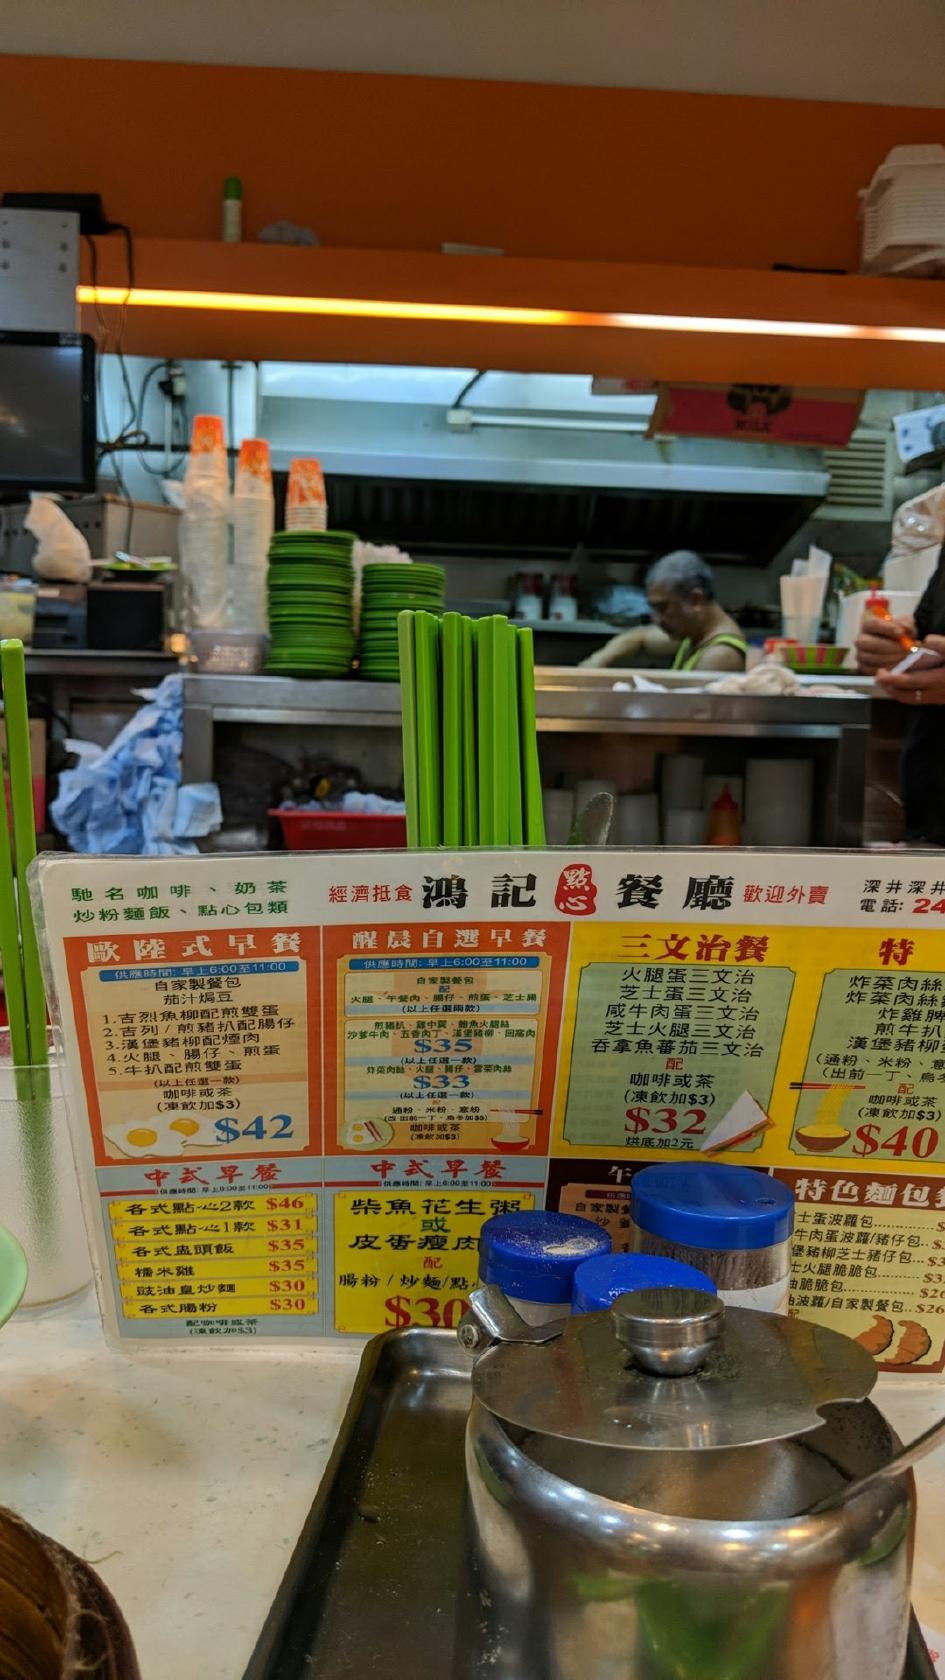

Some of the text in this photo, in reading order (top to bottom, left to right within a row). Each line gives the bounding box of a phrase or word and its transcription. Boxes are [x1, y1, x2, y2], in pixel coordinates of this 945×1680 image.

[71, 881, 287, 902] 馳名咖啡、奶茶
[329, 884, 413, 903] 經濟抵食
[422, 873, 736, 910] 鴻記 餐廳
[743, 884, 829, 905] 歡迎外賣
[73, 901, 288, 923] 炒粉麵飯、點心包類
[86, 933, 302, 963] 歐陸式早餐
[617, 933, 770, 963] 三文治餐
[879, 937, 915, 966] 特
[155, 977, 241, 991] 自家製餐包
[621, 967, 755, 985] 火腿蛋三文治
[164, 991, 233, 1006] 茄汁焗豆
[619, 985, 752, 1003] 芝士蛋三文治
[845, 991, 945, 1008] 炸菜肉絲
[605, 1003, 760, 1022] 咸牛肉蛋三文治
[604, 1021, 756, 1040] 芝士火腿三文治
[875, 1022, 942, 1039] 煎牛扒
[413, 1039, 473, 1053] $35
[847, 1036, 945, 1054] 漢堡豬柳
[665, 1058, 683, 1070] 配
[413, 1075, 470, 1089] $33
[630, 1073, 715, 1089] 咖啡或茶
[897, 1083, 915, 1095] 配
[164, 1087, 232, 1099] 咖啡或茶
[868, 1095, 938, 1108] 咖啡或茶
[214, 1114, 293, 1144] $42
[624, 1107, 707, 1135] $32
[851, 1123, 939, 1159] $40
[144, 1163, 283, 1187] 中式早餐
[370, 1159, 507, 1179] 中式早餐
[125, 1197, 305, 1216] 各式點心2款 $46
[351, 1198, 521, 1216] 柴魚花生粥
[128, 1219, 303, 1236] 各式點心1款 $31
[421, 1217, 451, 1233] 或
[797, 1210, 873, 1229] 士蛋波蘿包
[267, 1239, 305, 1252] $35
[348, 1234, 480, 1252] 皮蛋瘦肉
[268, 1259, 305, 1272] $35
[424, 1256, 443, 1269] 配
[269, 1280, 306, 1293] $30
[339, 1273, 476, 1290] 腸粉/炒麵/點
[923, 1273, 945, 1284] $3
[269, 1298, 306, 1311] $30
